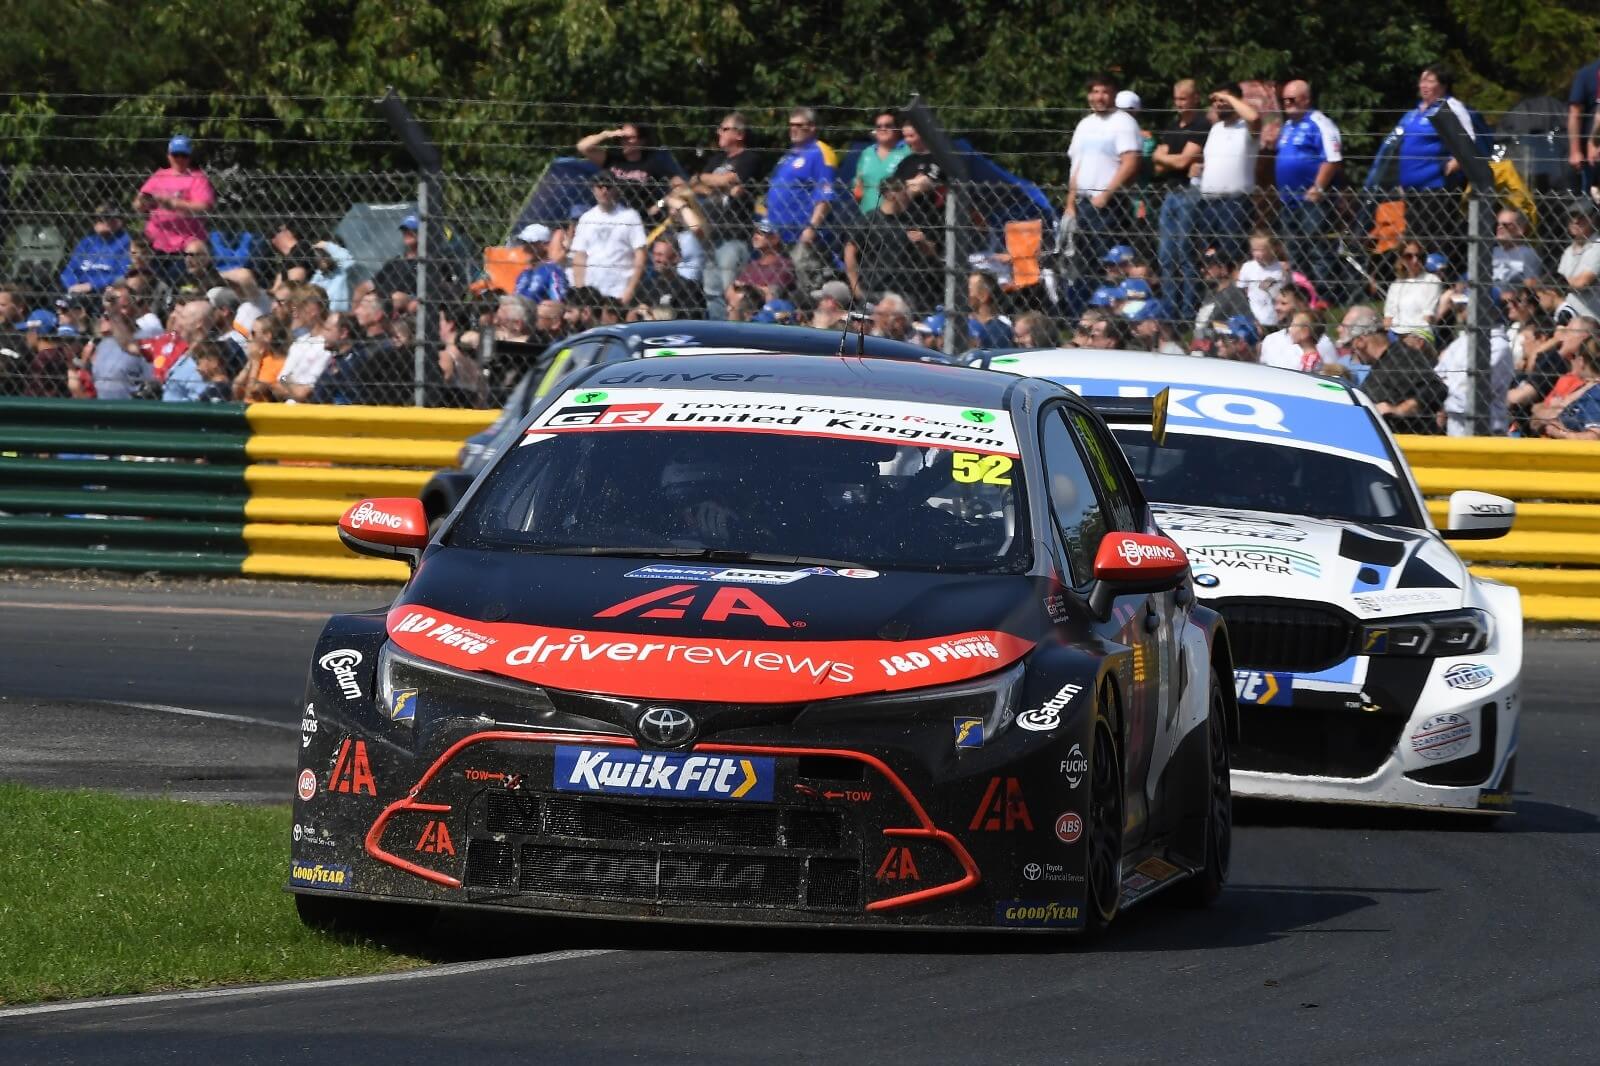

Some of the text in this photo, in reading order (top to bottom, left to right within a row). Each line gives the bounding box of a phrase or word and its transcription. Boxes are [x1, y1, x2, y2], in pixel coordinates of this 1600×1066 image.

[1062, 384, 1293, 433] KQ
[678, 402, 786, 412] TOYOTA
[902, 414, 995, 435] Racing
[665, 412, 1004, 448] United Kingdom
[952, 452, 1013, 486] 52
[1186, 547, 1291, 565] NITION
[1210, 558, 1293, 577] WATER
[425, 623, 489, 655] Pierce
[878, 641, 1000, 677] J&D Pierce
[328, 656, 362, 700] Saturn
[1028, 682, 1083, 726] Saturn
[464, 769, 489, 781] TOW
[1060, 759, 1088, 773] FUCHS
[300, 777, 315, 791] ABS
[844, 790, 872, 801] TOW
[1060, 820, 1081, 834] ABS
[293, 865, 345, 885] GOODYEAR
[1045, 863, 1064, 873] Toyota
[1005, 903, 1080, 922] GOODYEAR
